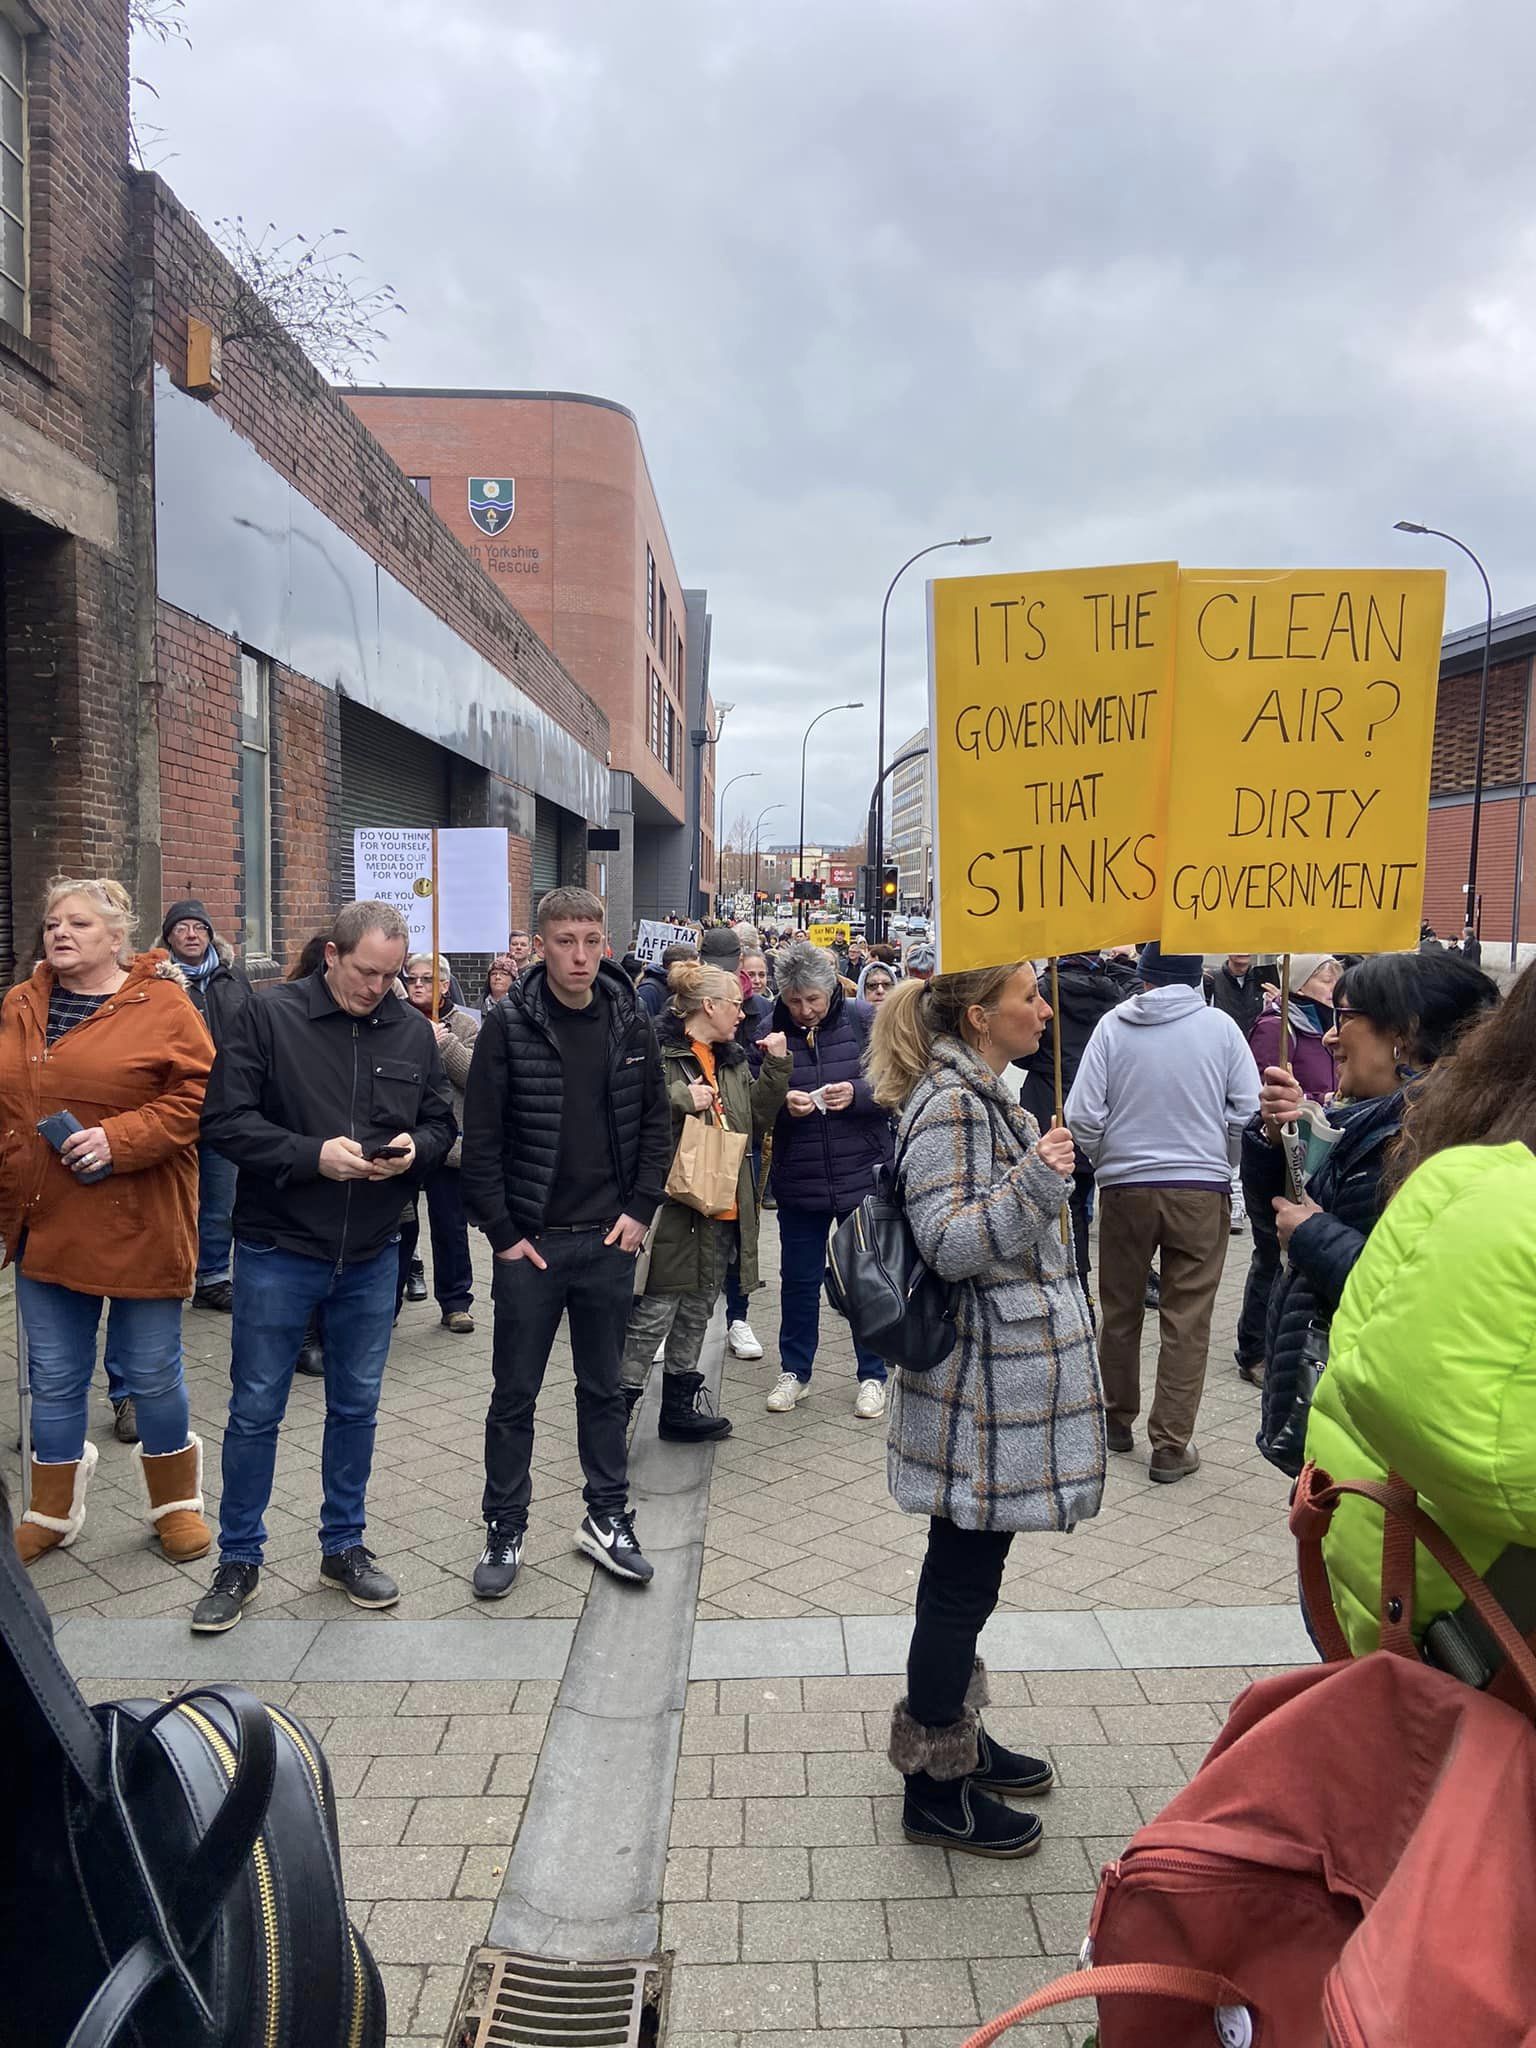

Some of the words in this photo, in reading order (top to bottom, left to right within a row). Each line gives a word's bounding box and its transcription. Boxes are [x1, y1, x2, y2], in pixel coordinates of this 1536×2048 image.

[485, 544, 539, 559] Yorkshire
[488, 558, 540, 573] Rescue
[974, 596, 1047, 666] IT'S
[1083, 590, 1158, 653] THE
[1197, 591, 1406, 662] CLEAN
[955, 689, 1158, 761] GOVERNMENT
[1024, 772, 1104, 825] THAT
[1227, 787, 1381, 839] DIRTY
[360, 832, 375, 840] DO
[378, 832, 399, 840] YOU
[402, 833, 430, 841] THINK
[360, 842, 378, 850] FOR
[407, 854, 426, 862] OUR
[394, 872, 417, 880] YOU!
[966, 833, 1157, 917] STINKS
[374, 892, 392, 900] ARE
[395, 892, 415, 900] YOU
[1173, 862, 1419, 921] GOVERNMENT
[674, 927, 697, 943] TAX
[637, 948, 654, 960] US
